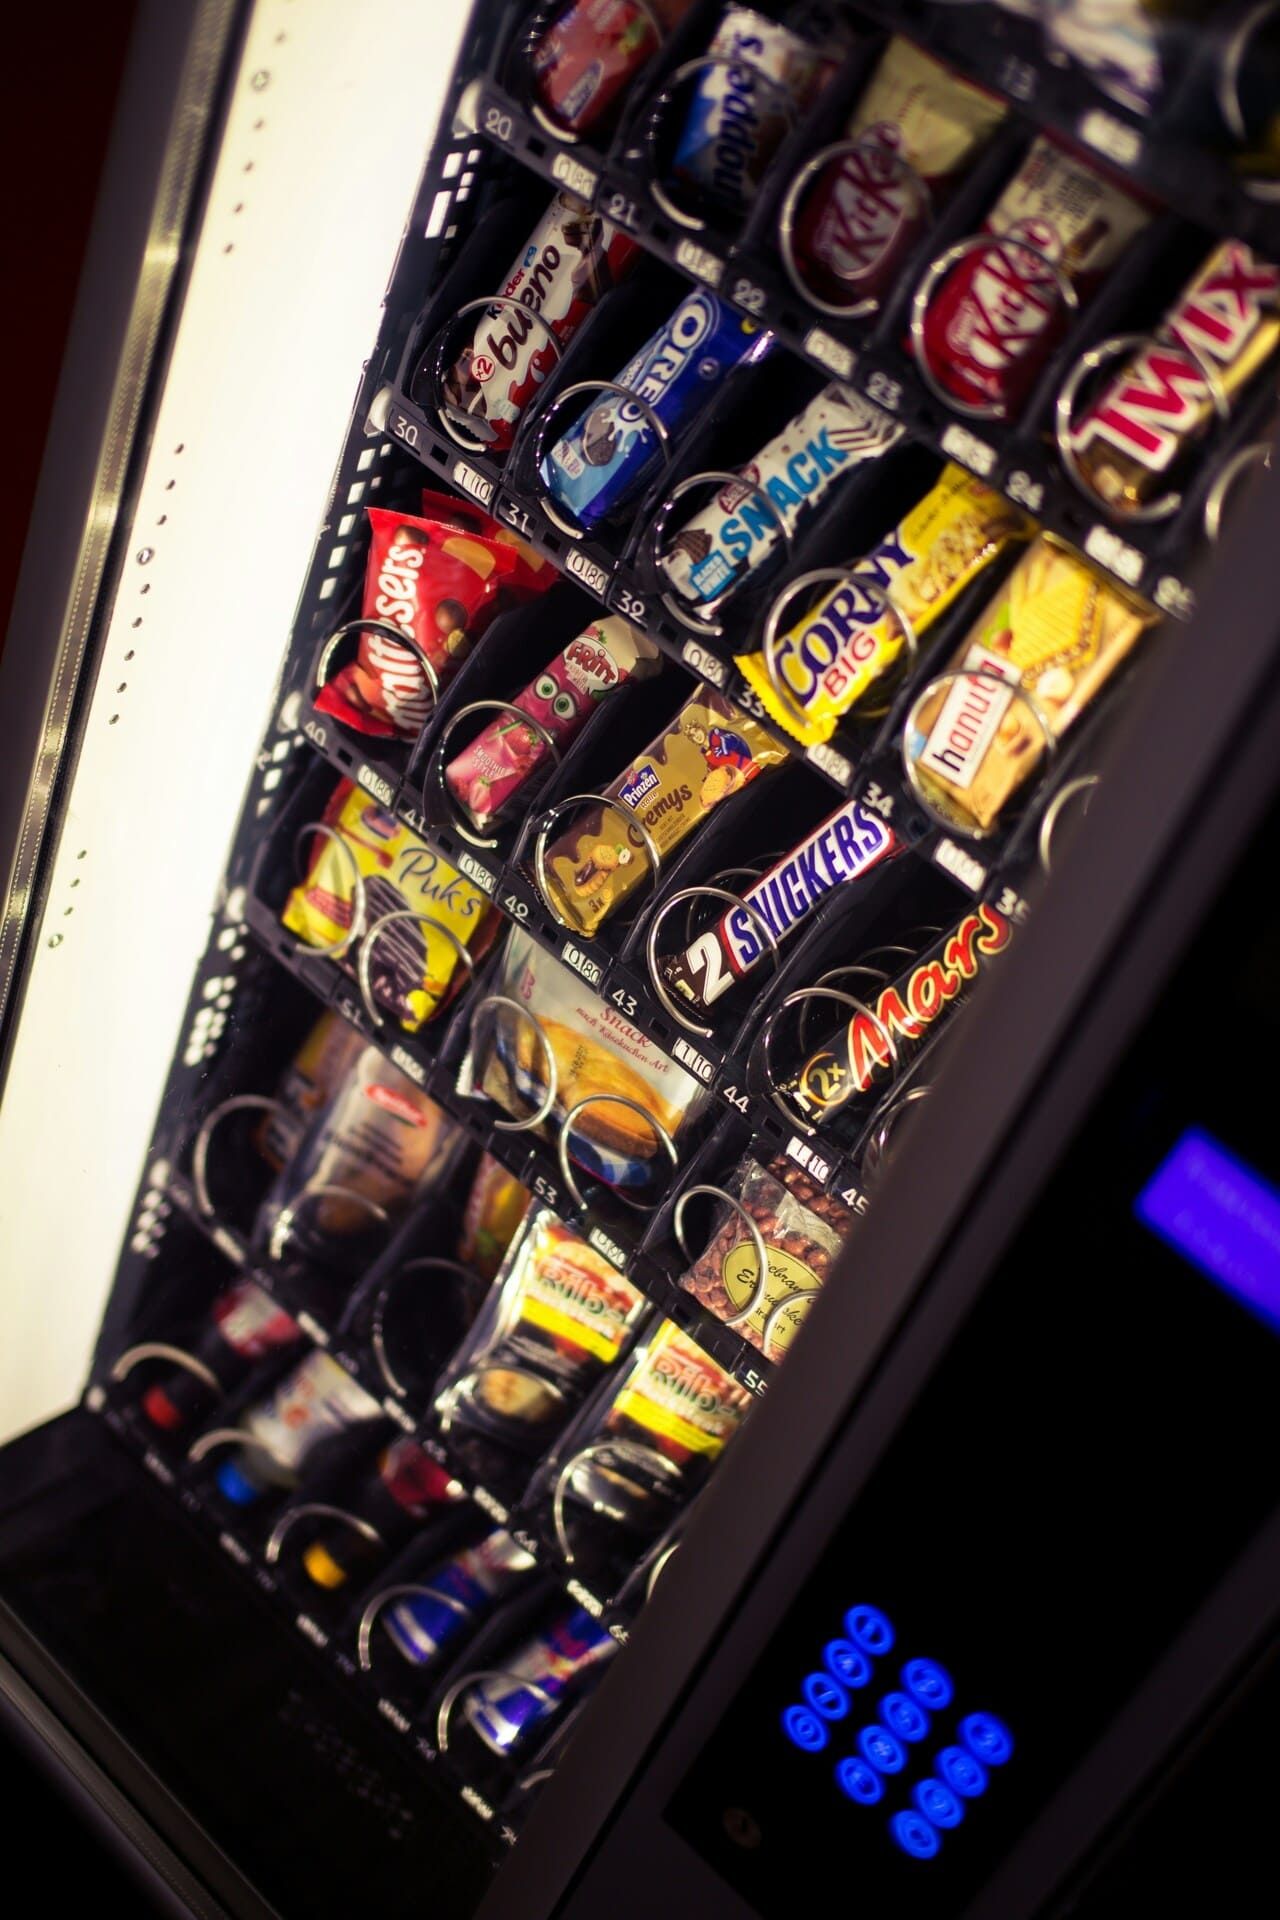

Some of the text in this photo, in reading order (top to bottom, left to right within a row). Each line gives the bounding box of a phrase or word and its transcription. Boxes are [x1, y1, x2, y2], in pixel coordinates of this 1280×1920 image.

[485, 109, 512, 140] 20
[608, 195, 634, 226] 21
[487, 245, 561, 370] bueno
[733, 279, 766, 312] 22
[1071, 246, 1278, 454] TWIX
[866, 370, 901, 409] 23
[394, 415, 418, 445] 30
[720, 426, 849, 560] SNACK
[504, 504, 530, 533] 31
[617, 592, 646, 620] 32
[775, 529, 914, 706] CORNY
[823, 631, 877, 698] BIG
[304, 721, 326, 748] 40
[623, 774, 657, 806] Prinzen
[861, 782, 894, 818] 34
[404, 809, 426, 834] 41
[504, 894, 529, 919] 42
[686, 932, 735, 1006] 2
[729, 803, 884, 965] SNICKERS
[612, 988, 638, 1016] 43
[848, 902, 1012, 1091] Mars
[600, 1006, 652, 1048] Snack
[723, 1085, 751, 1113] 44
[533, 1177, 558, 1204] 53
[841, 1188, 870, 1214] 45
[743, 1369, 767, 1398] 55
